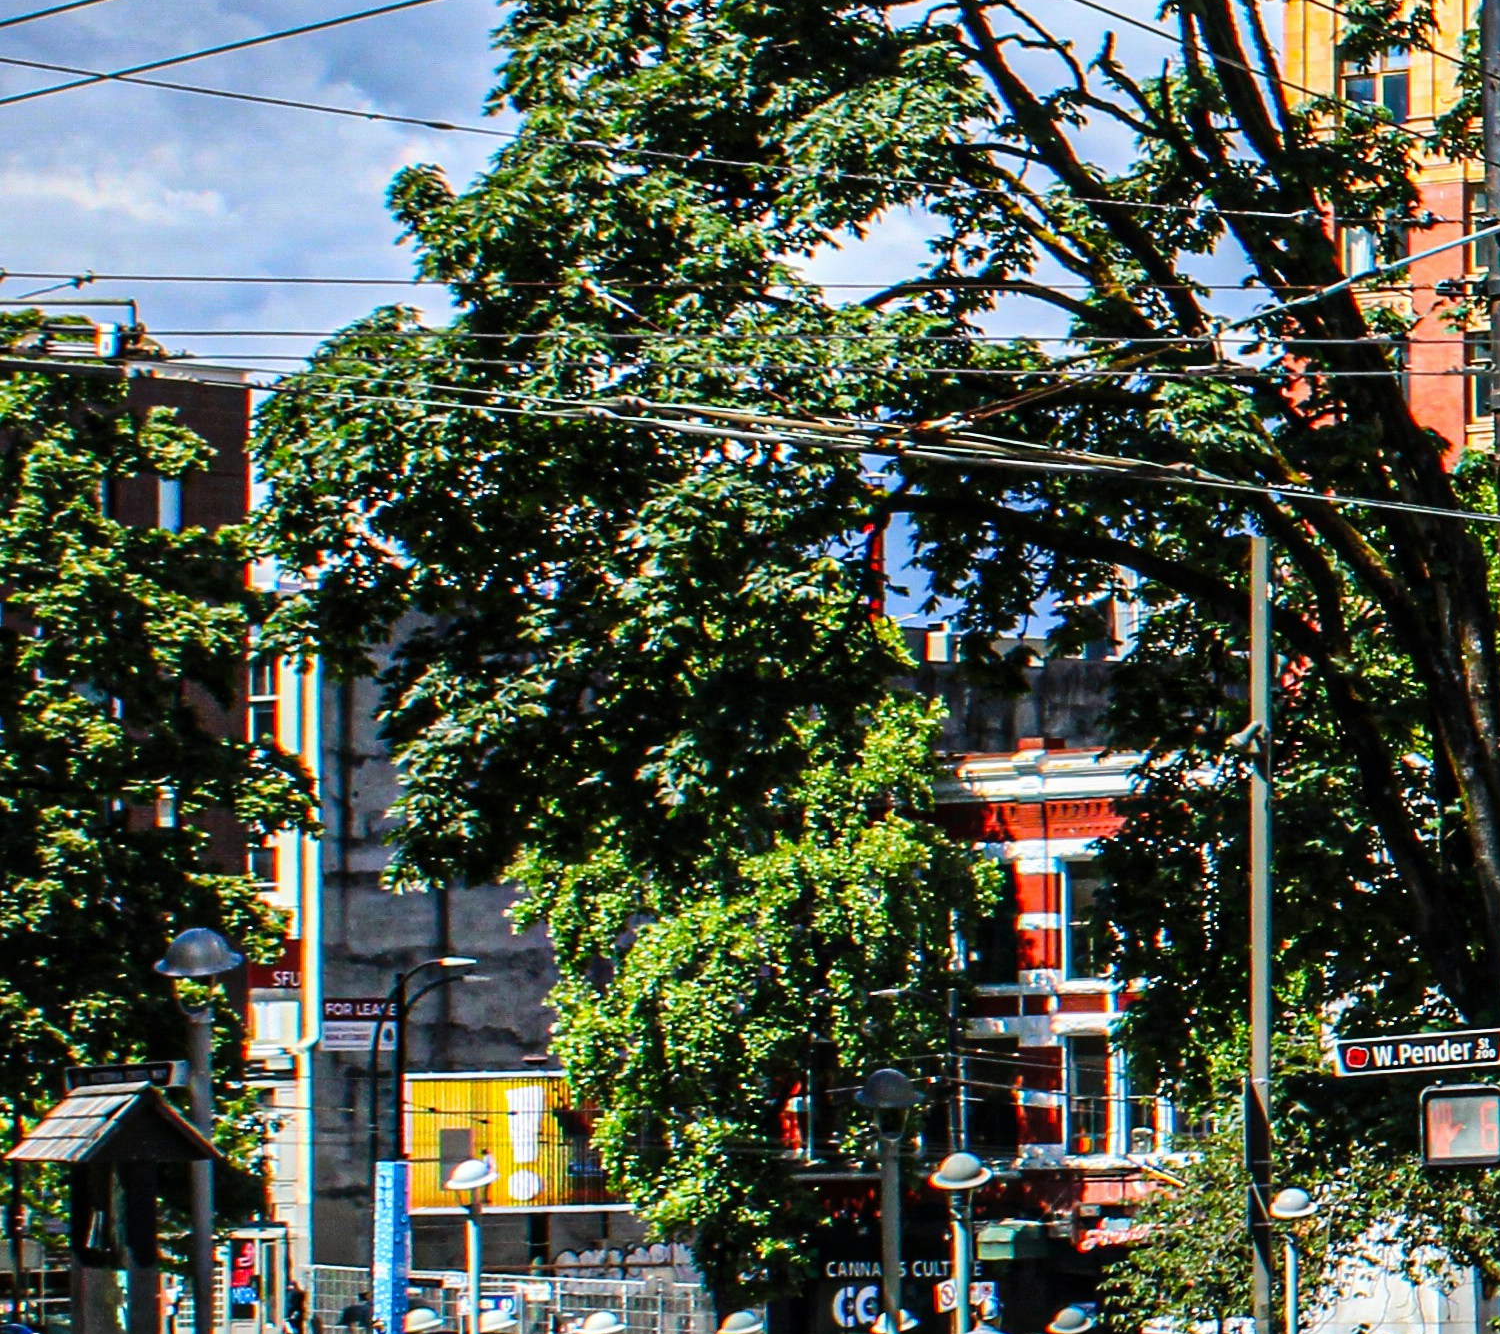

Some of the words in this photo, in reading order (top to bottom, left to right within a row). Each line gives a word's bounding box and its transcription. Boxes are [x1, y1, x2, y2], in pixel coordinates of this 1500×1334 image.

[273, 971, 300, 987] SFU
[326, 1003, 352, 1016] FOR
[356, 1003, 397, 1016] LEAE
[1477, 1038, 1490, 1049] St
[1475, 1048, 1496, 1060] 200
[1480, 1101, 1498, 1151] 6
[826, 1261, 906, 1278] CANNAS
[911, 1260, 983, 1277] CULTE
